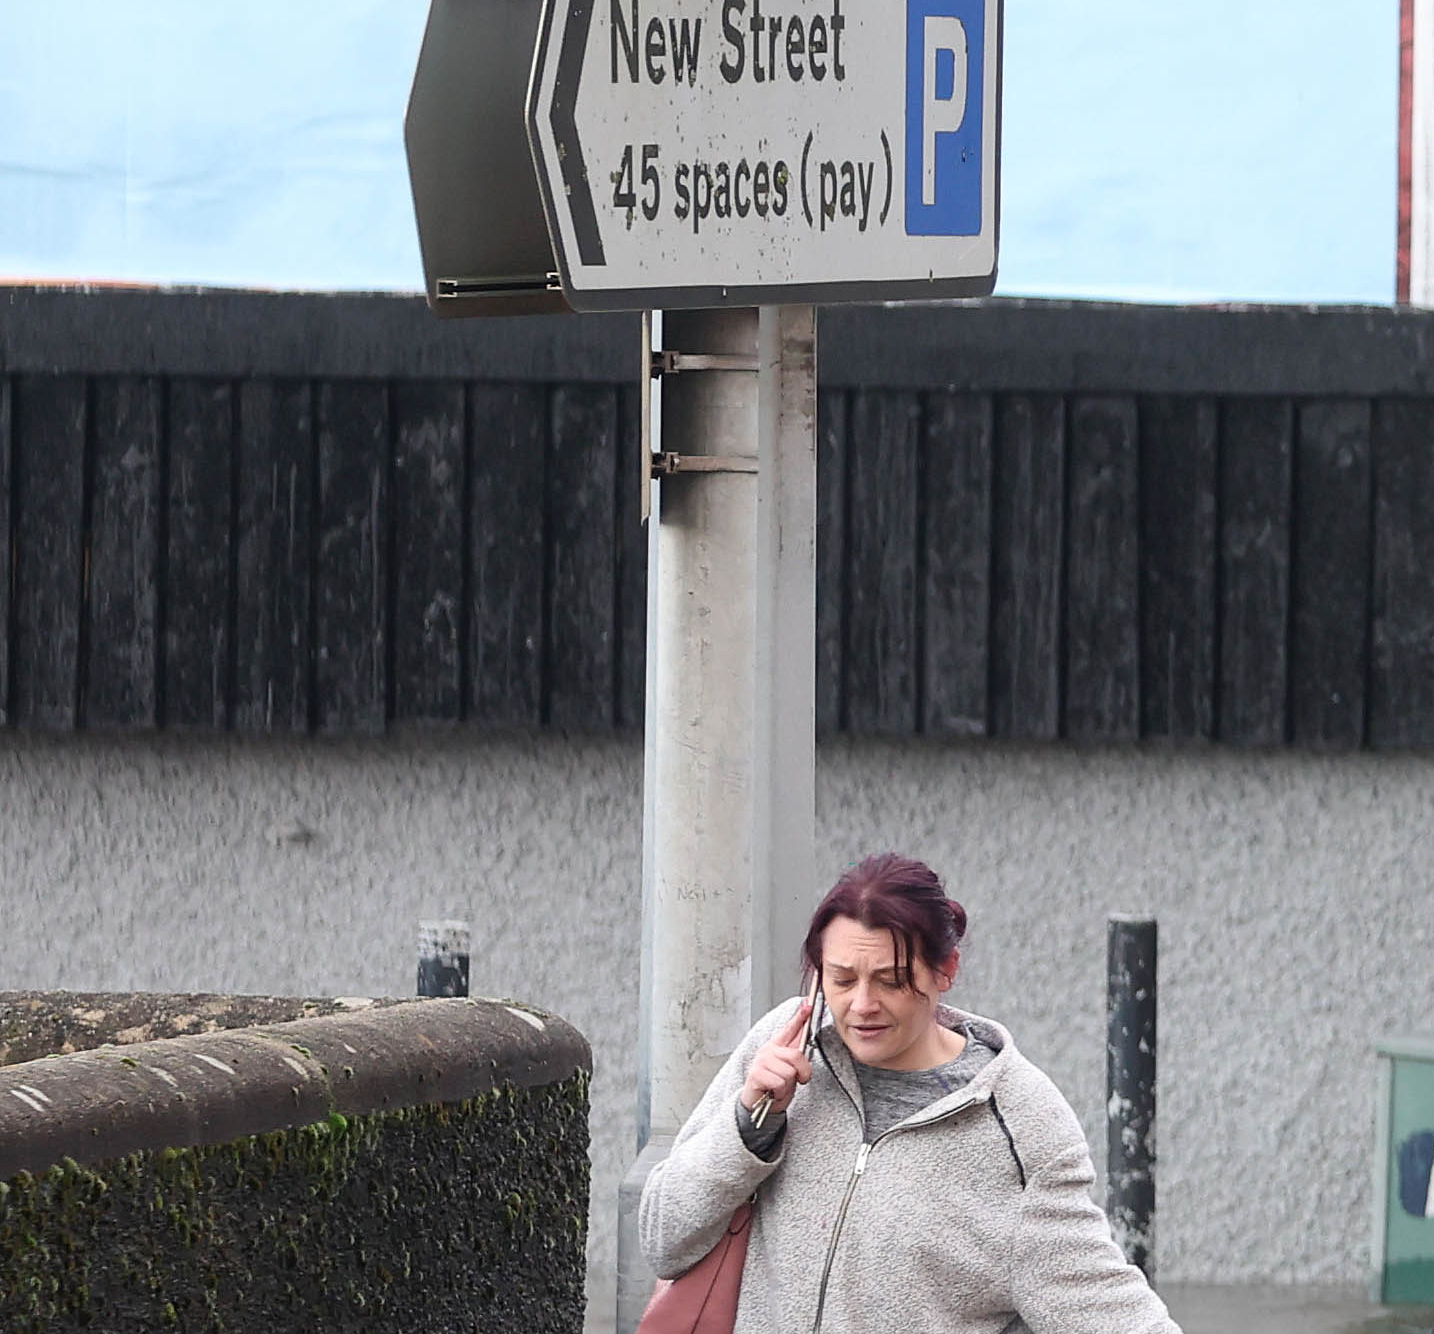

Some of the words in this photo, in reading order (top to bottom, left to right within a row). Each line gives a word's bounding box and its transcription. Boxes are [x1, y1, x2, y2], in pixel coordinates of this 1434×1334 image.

[612, 145, 661, 222] 45
[675, 154, 789, 234] spaces
[801, 128, 893, 231] (pay)
[923, 16, 967, 205] P
